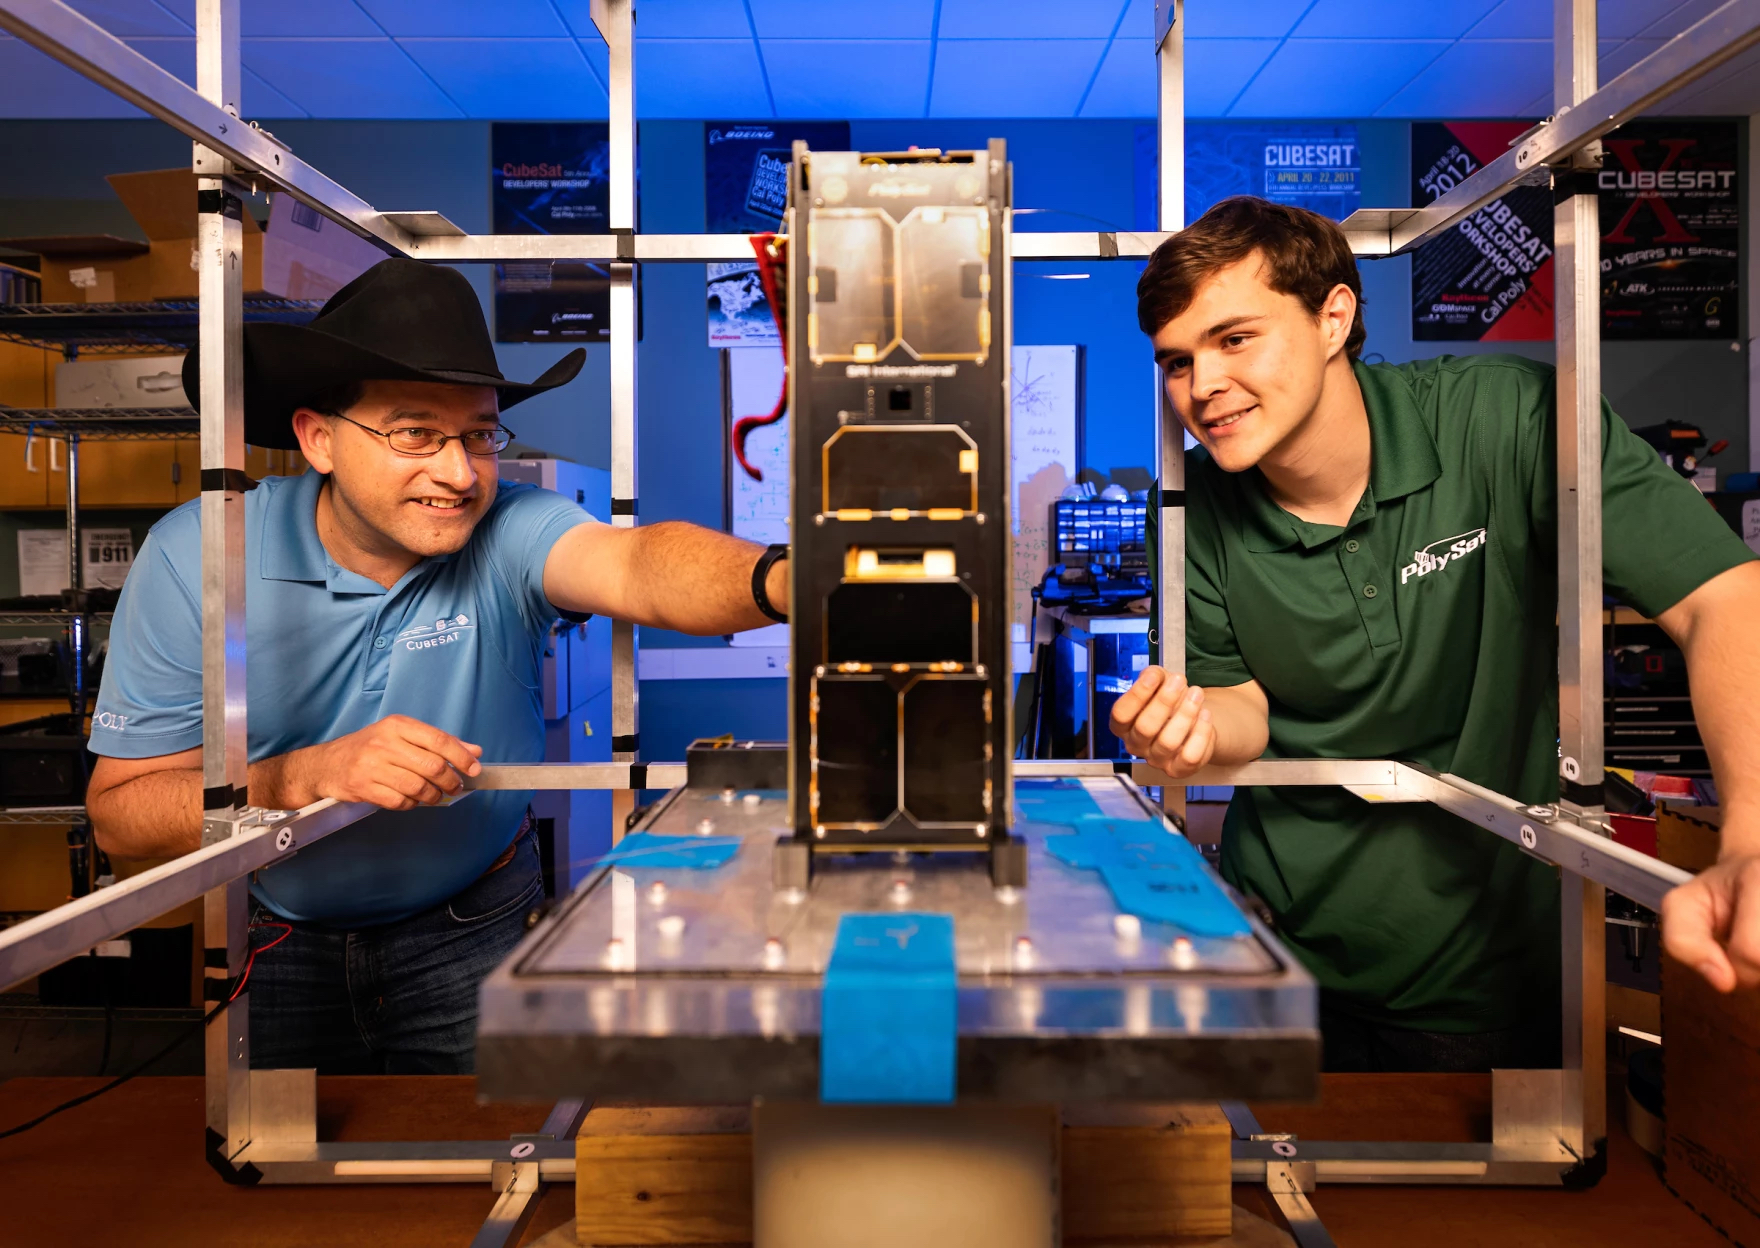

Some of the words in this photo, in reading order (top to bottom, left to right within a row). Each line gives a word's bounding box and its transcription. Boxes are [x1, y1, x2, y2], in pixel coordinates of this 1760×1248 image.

[1265, 145, 1355, 166] CUBESAT
[503, 162, 562, 177] CubeSat
[1419, 165, 1440, 188] April
[1425, 153, 1477, 200] 2012
[1598, 171, 1736, 189] CUBESAT
[1469, 209, 1537, 273] VELOPERS'
[1483, 198, 1553, 262] UBESAT
[1459, 219, 1517, 276] ORKSHOP
[1615, 248, 1666, 265] YEARS
[1688, 247, 1737, 257] SPACE
[1627, 284, 1648, 293] ATK
[1481, 299, 1503, 323] Cal
[1498, 278, 1526, 306] Poly
[103, 546, 128, 562] 911
[1401, 530, 1487, 584] PolySat
